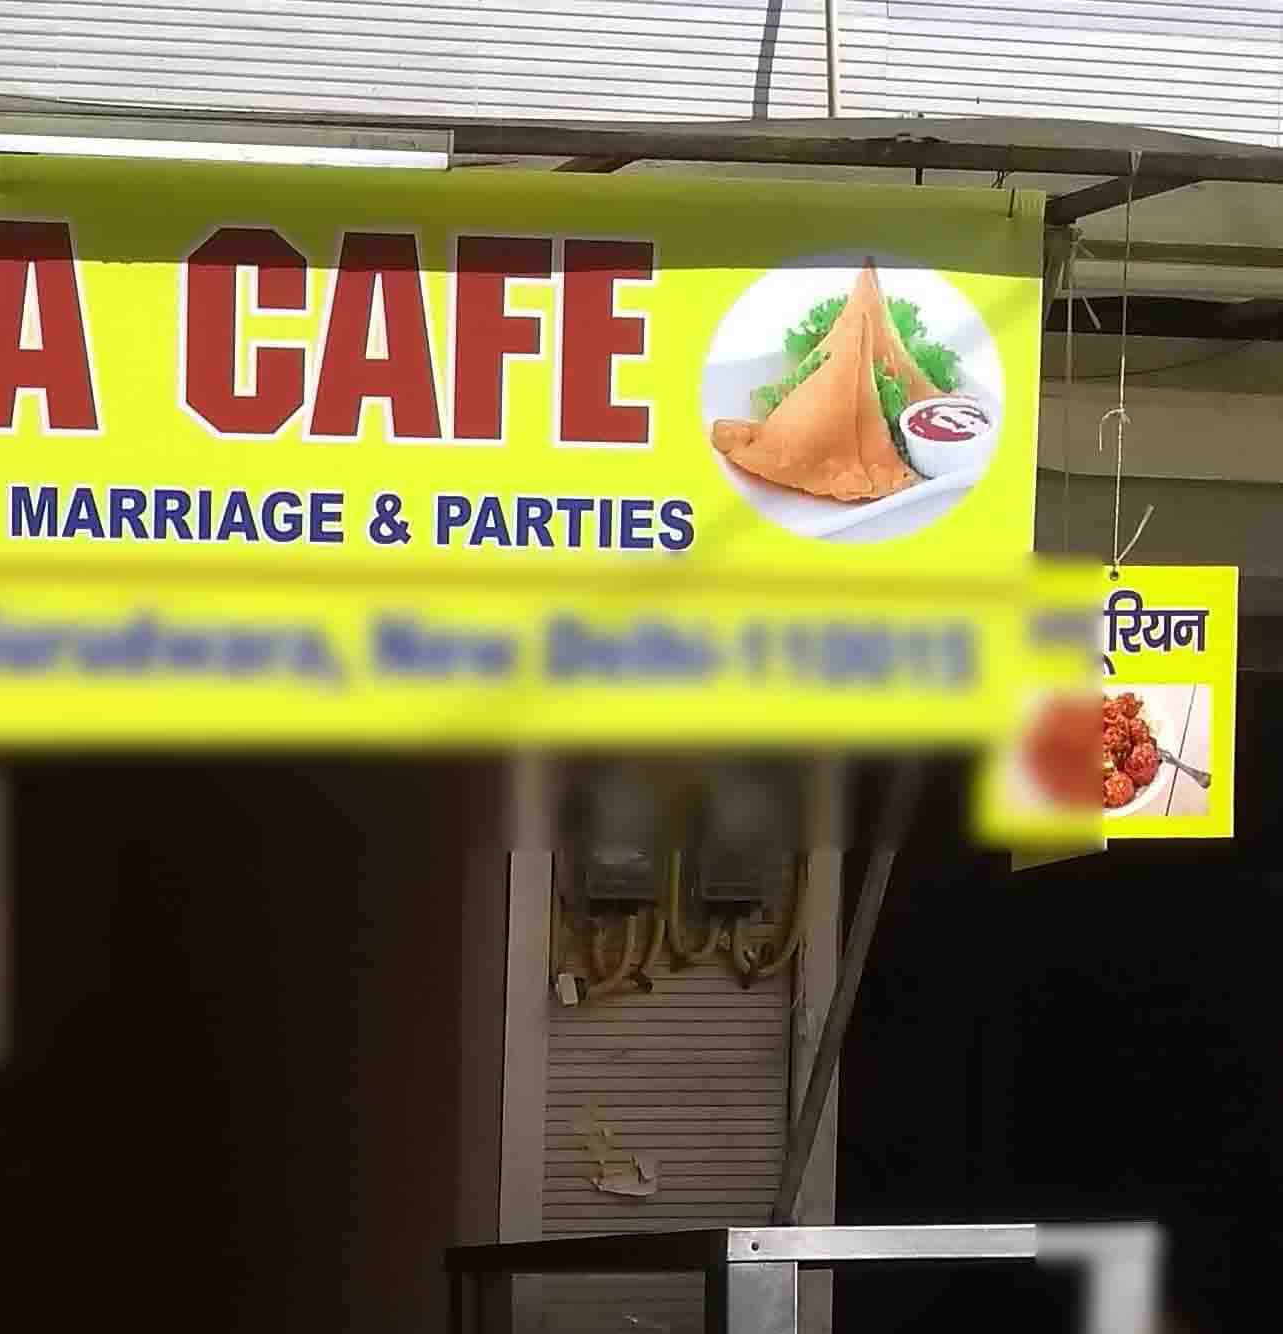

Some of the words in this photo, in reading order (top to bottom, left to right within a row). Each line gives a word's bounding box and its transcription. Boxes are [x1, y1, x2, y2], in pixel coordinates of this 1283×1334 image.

[182, 228, 655, 446] CAFE
[10, 487, 342, 543] MARRIAGE
[368, 494, 409, 545] &
[436, 496, 694, 550] PARTIES
